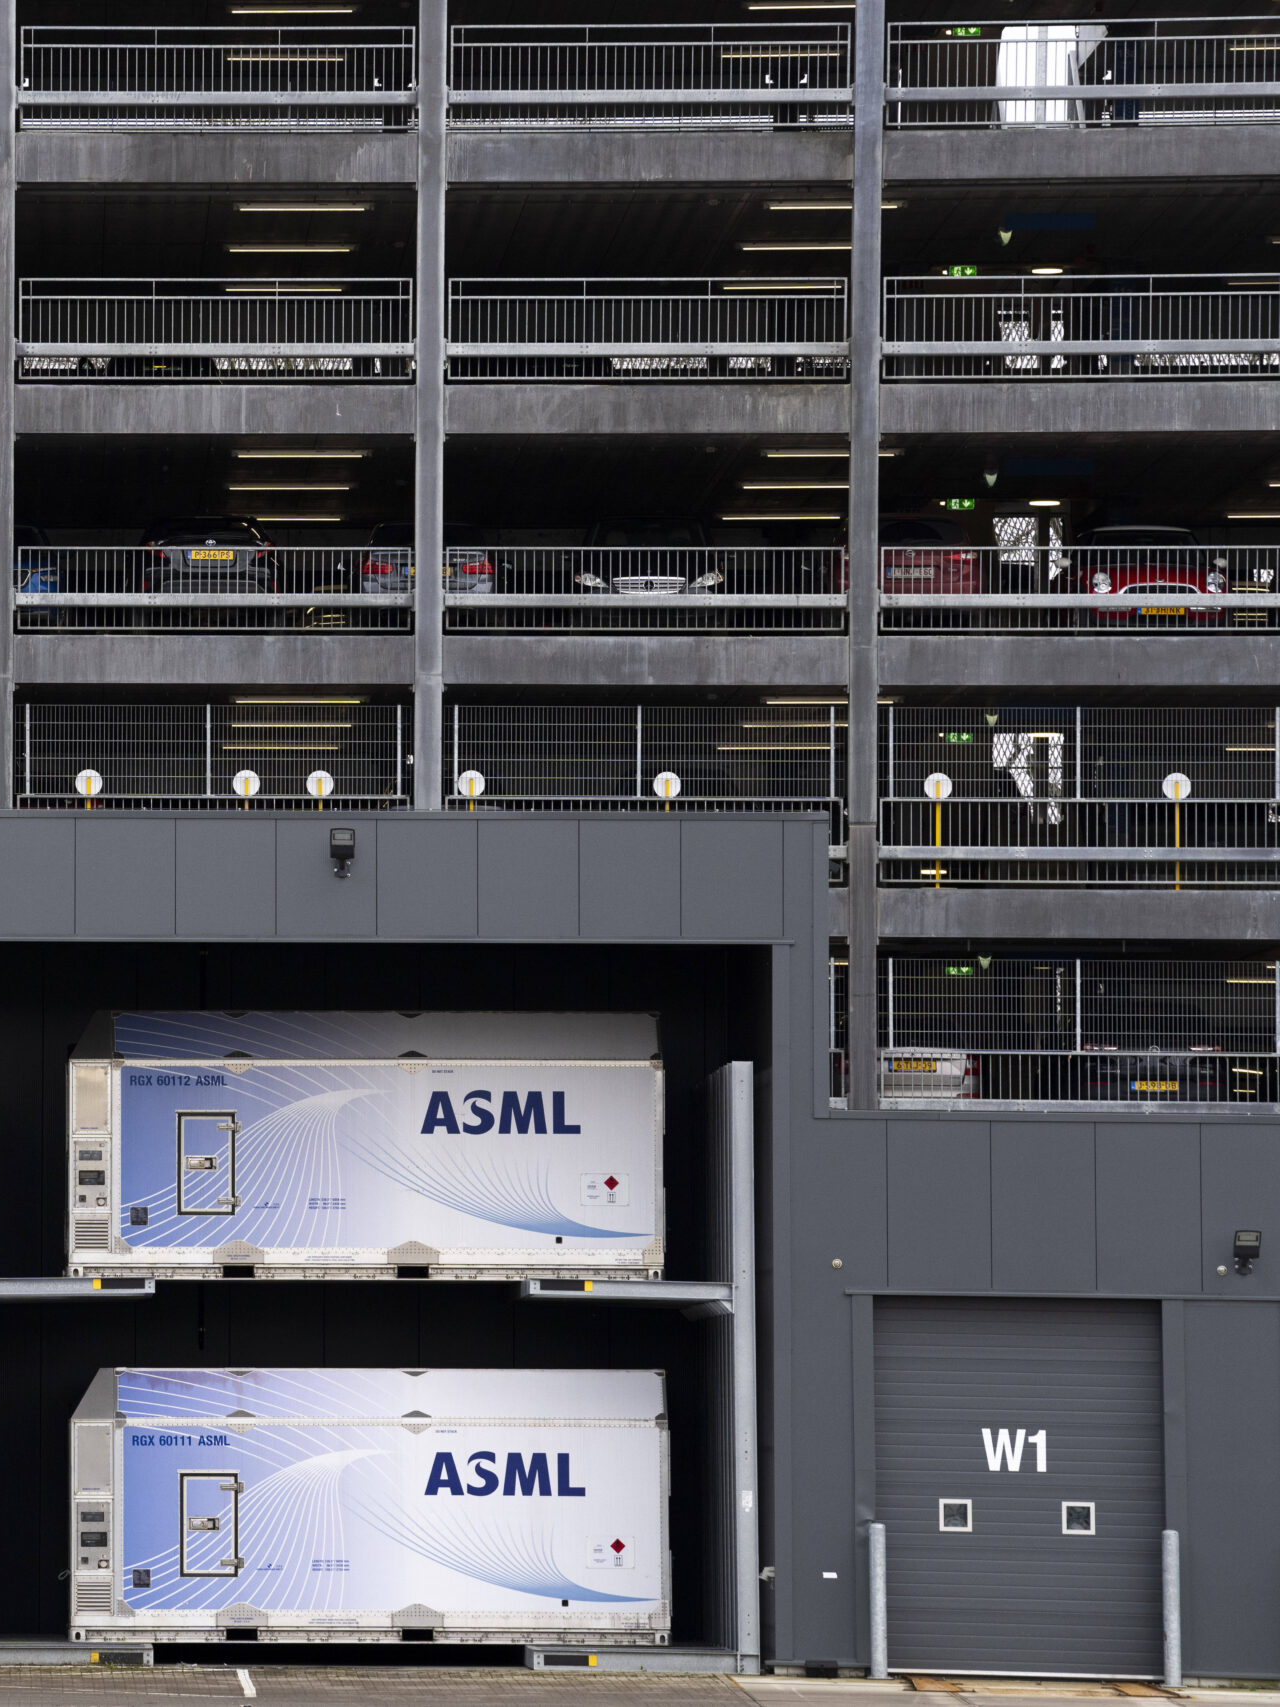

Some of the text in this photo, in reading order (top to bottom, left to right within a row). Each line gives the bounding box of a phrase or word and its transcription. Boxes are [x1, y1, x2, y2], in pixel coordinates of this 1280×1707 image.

[194, 551, 231, 559] P-366PS
[129, 1075, 228, 1087] RGX 60112 ASML
[420, 1089, 581, 1135] ASML
[131, 1435, 230, 1446] RGX 60111 ASML
[981, 1428, 1047, 1472] W1
[424, 1451, 586, 1496] ASML
